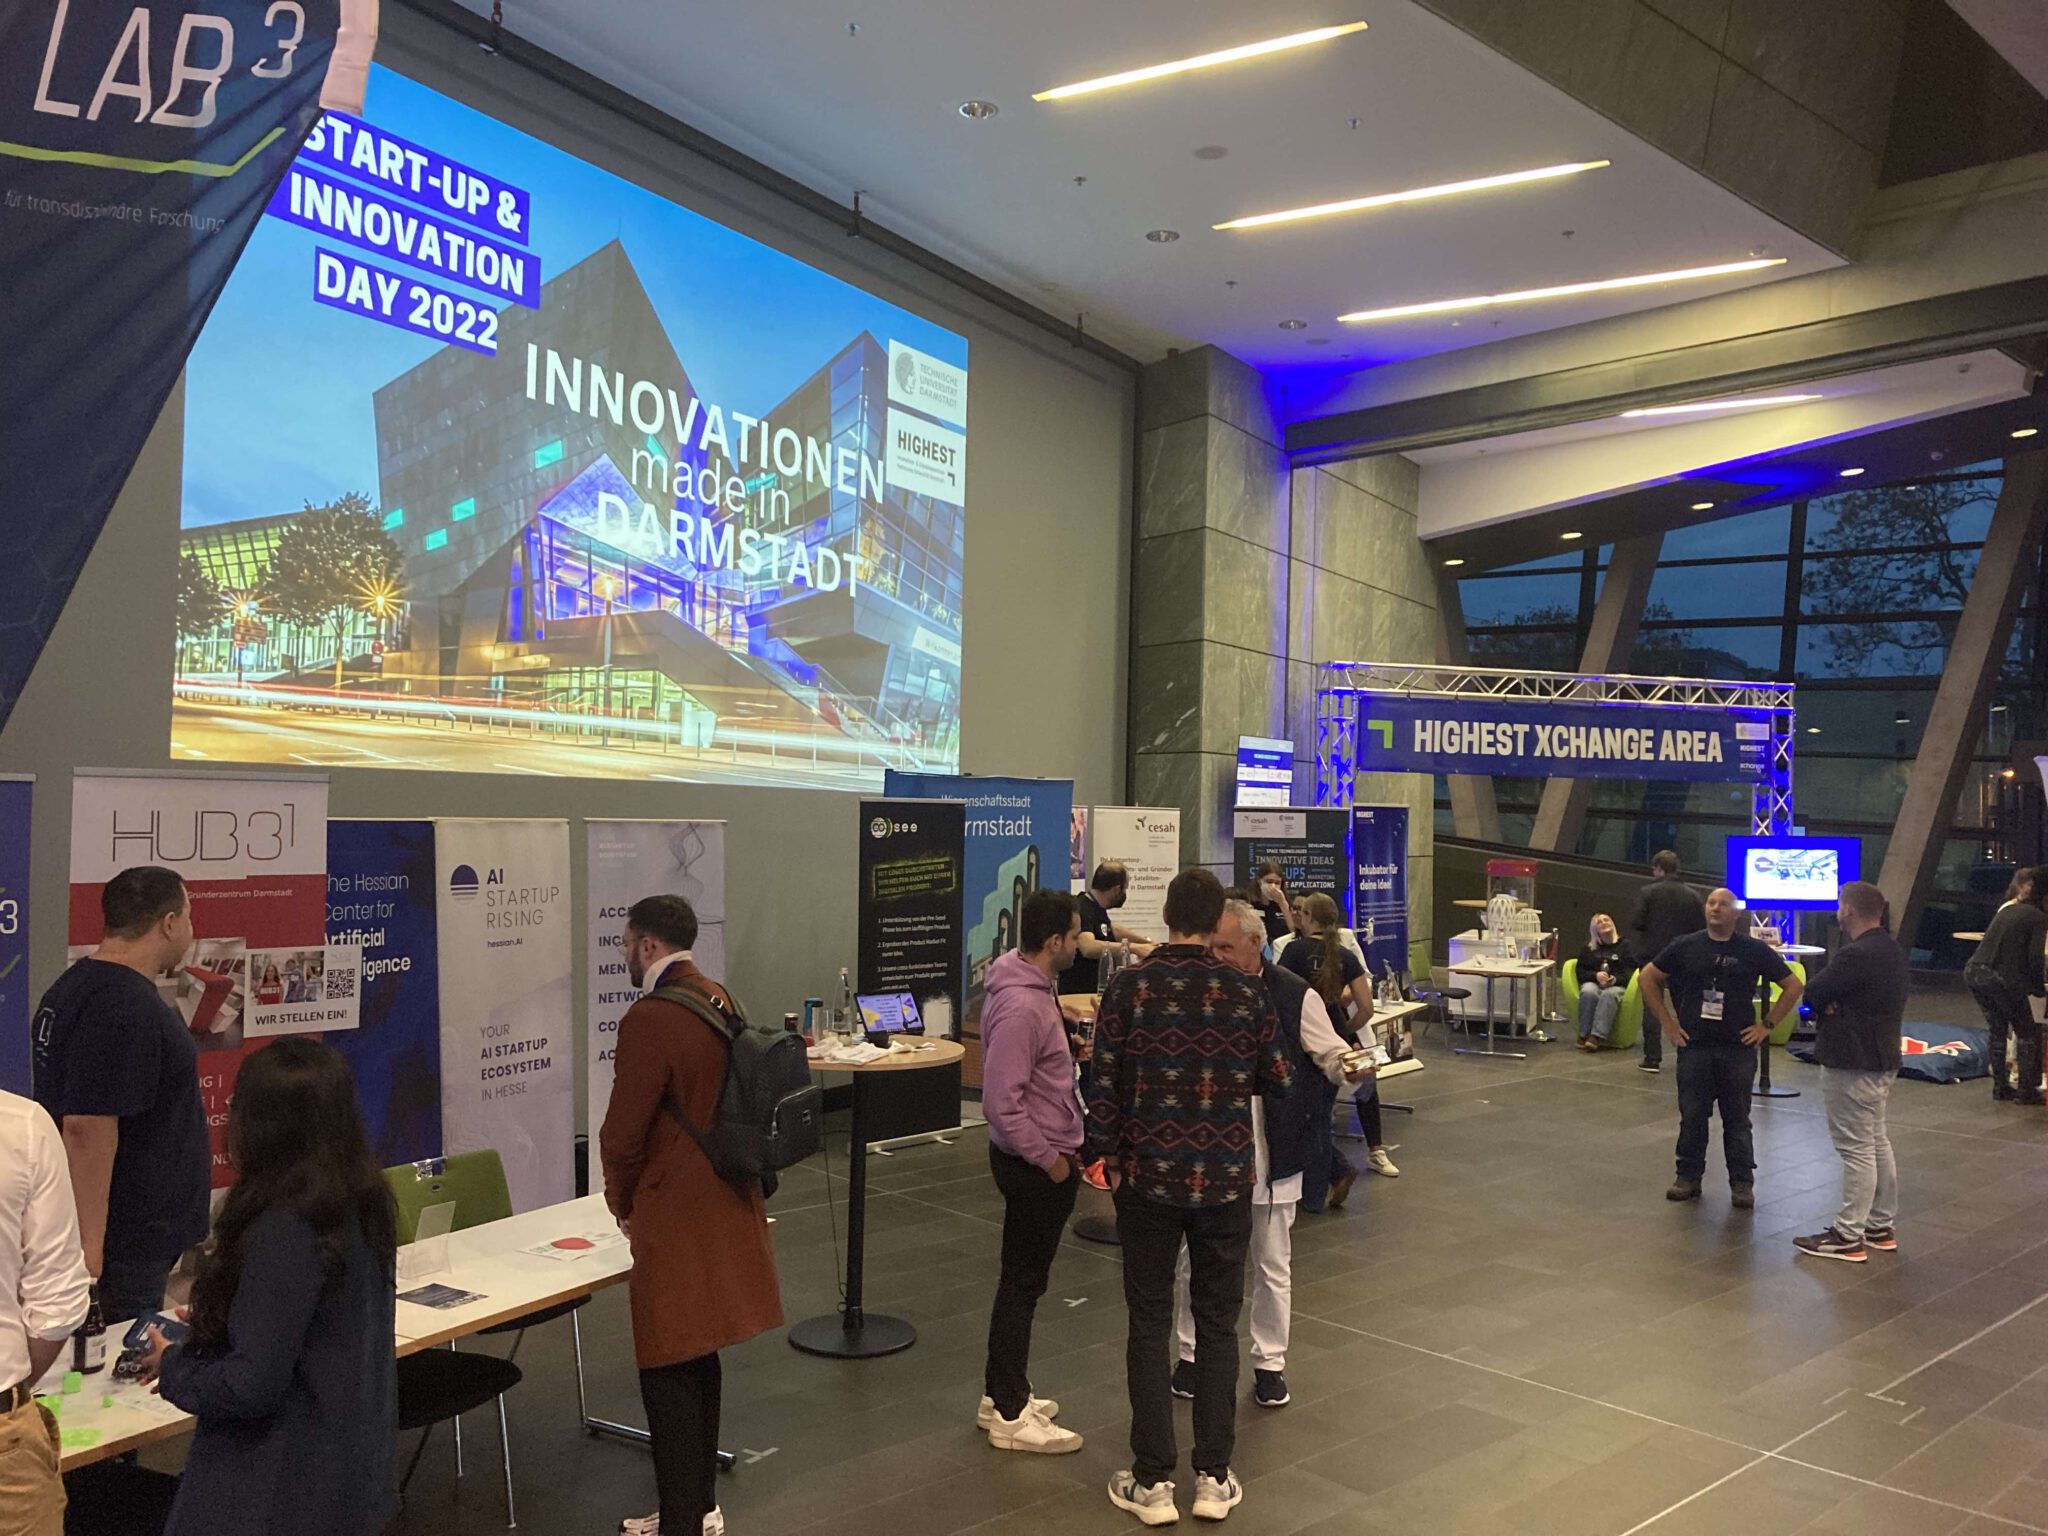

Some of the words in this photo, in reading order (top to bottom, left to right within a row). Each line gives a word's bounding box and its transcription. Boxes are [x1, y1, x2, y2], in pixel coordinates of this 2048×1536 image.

[304, 115, 490, 215] START-UP
[496, 190, 522, 233] &
[290, 172, 524, 297] INNOVATION
[318, 253, 401, 316] DAY
[408, 286, 499, 350] 2022
[919, 374, 958, 397] UNIVERSITÄT
[920, 363, 958, 387] TECHNISCHE
[919, 387, 957, 409] DARMSTADT
[526, 343, 885, 504] INNOVATIONEN
[897, 429, 956, 467] HIGHEST
[631, 447, 747, 513] made
[759, 470, 790, 525] in
[597, 491, 864, 598] DARMSTADT
[1414, 719, 1530, 757] HIGHEST
[1533, 724, 1655, 762] XCHANGE
[1658, 730, 1724, 763] AREA
[112, 803, 295, 862] HUB31
[963, 815, 1033, 837] rmstadt
[1148, 822, 1175, 833] cesah
[1255, 856, 1307, 866] INNOVATIVE
[1309, 856, 1335, 866] IDEAS
[1359, 864, 1390, 875] Inkubator
[1389, 863, 1399, 874] für
[327, 873, 351, 893] he
[355, 872, 409, 892] Hessian
[486, 867, 504, 885] AI
[1360, 879, 1377, 890] deine
[253, 888, 293, 898] Darmstadt
[486, 886, 560, 908] STARTUP
[376, 900, 396, 919] for
[486, 909, 544, 929] RISING
[255, 1014, 277, 1026] WIR
[279, 1010, 325, 1024] STELLEN
[327, 1009, 348, 1020] EIN!
[480, 1023, 511, 1039] YOUR
[480, 1047, 492, 1060] AI
[495, 1037, 549, 1057] STARTUP
[481, 1056, 552, 1081] ECOSYSTEM
[481, 1088, 493, 1101] IN
[495, 1081, 528, 1099] HESSE
